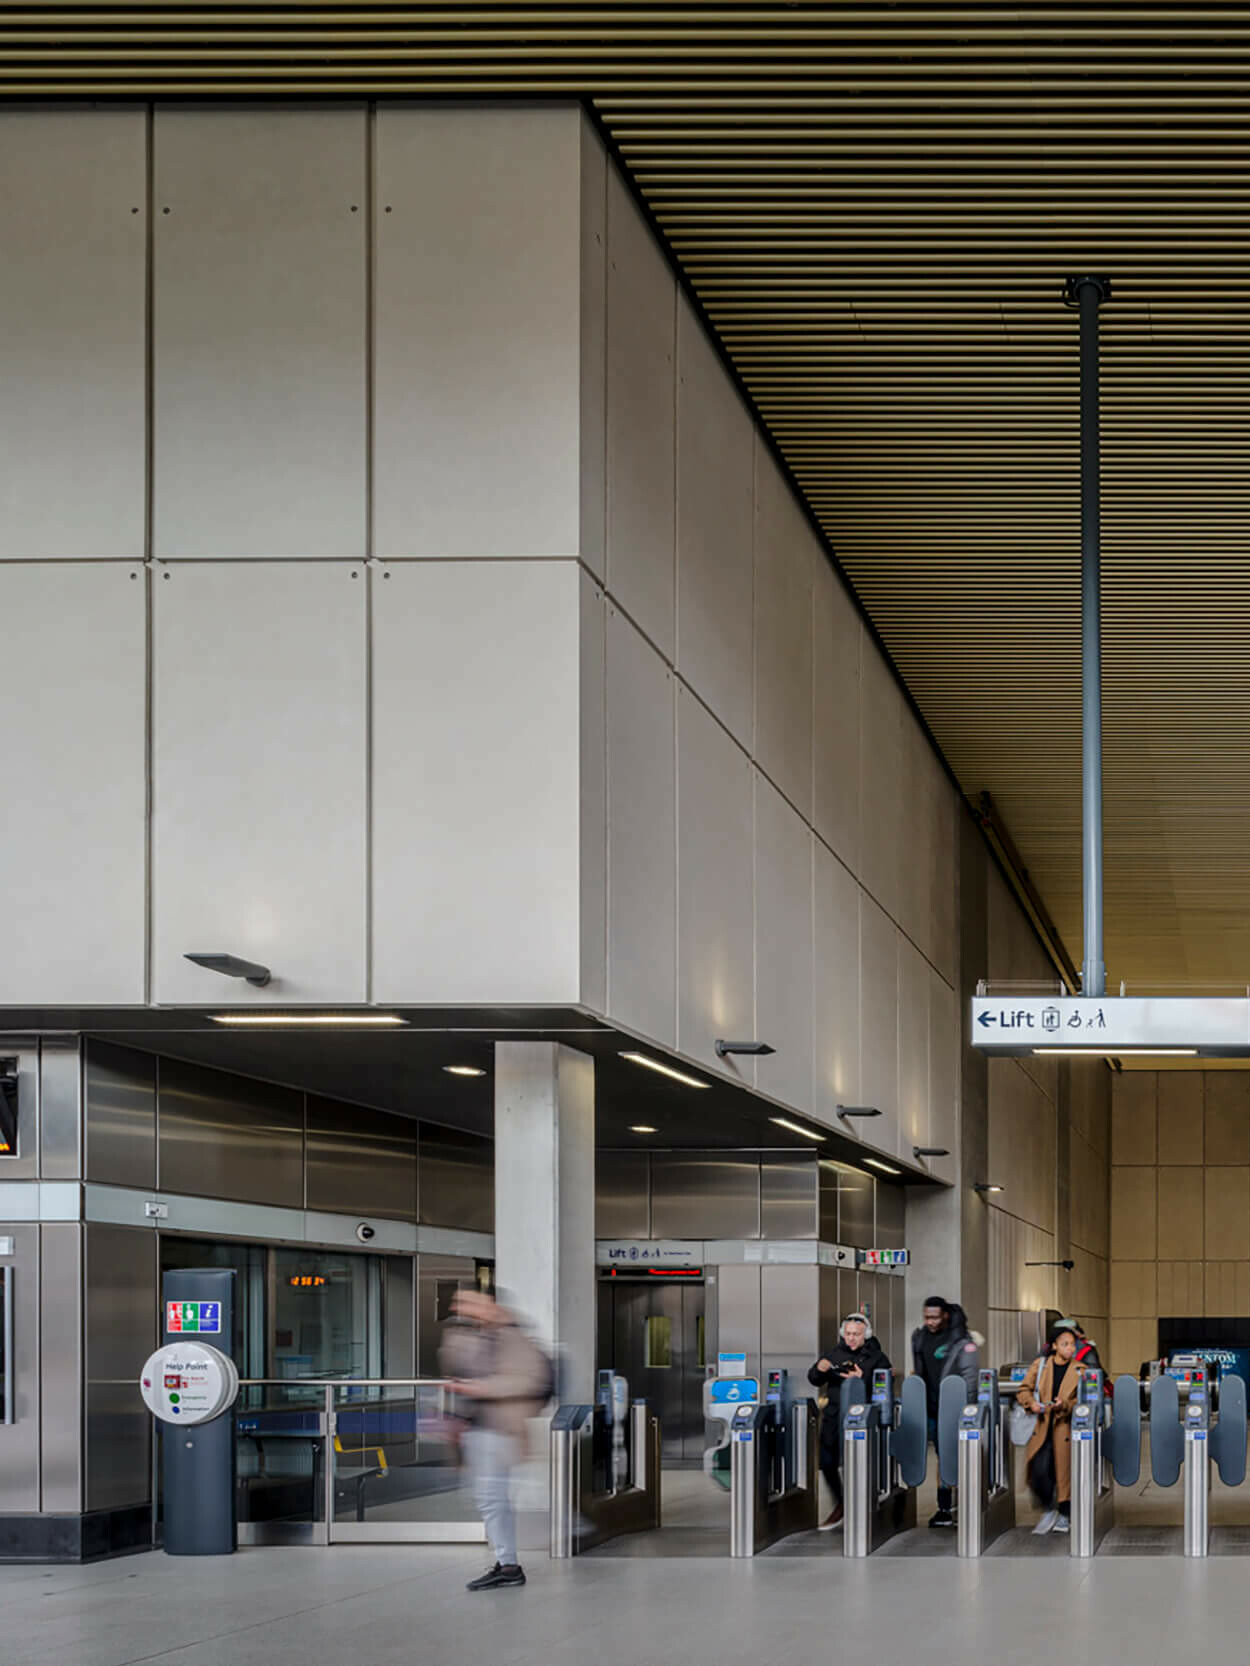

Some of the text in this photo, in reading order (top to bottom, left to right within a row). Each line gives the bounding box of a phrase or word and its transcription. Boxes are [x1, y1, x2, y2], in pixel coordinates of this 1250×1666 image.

[1000, 1010, 1035, 1028] Lift
[609, 1248, 627, 1258] Lift
[166, 1363, 208, 1371] Help Point
